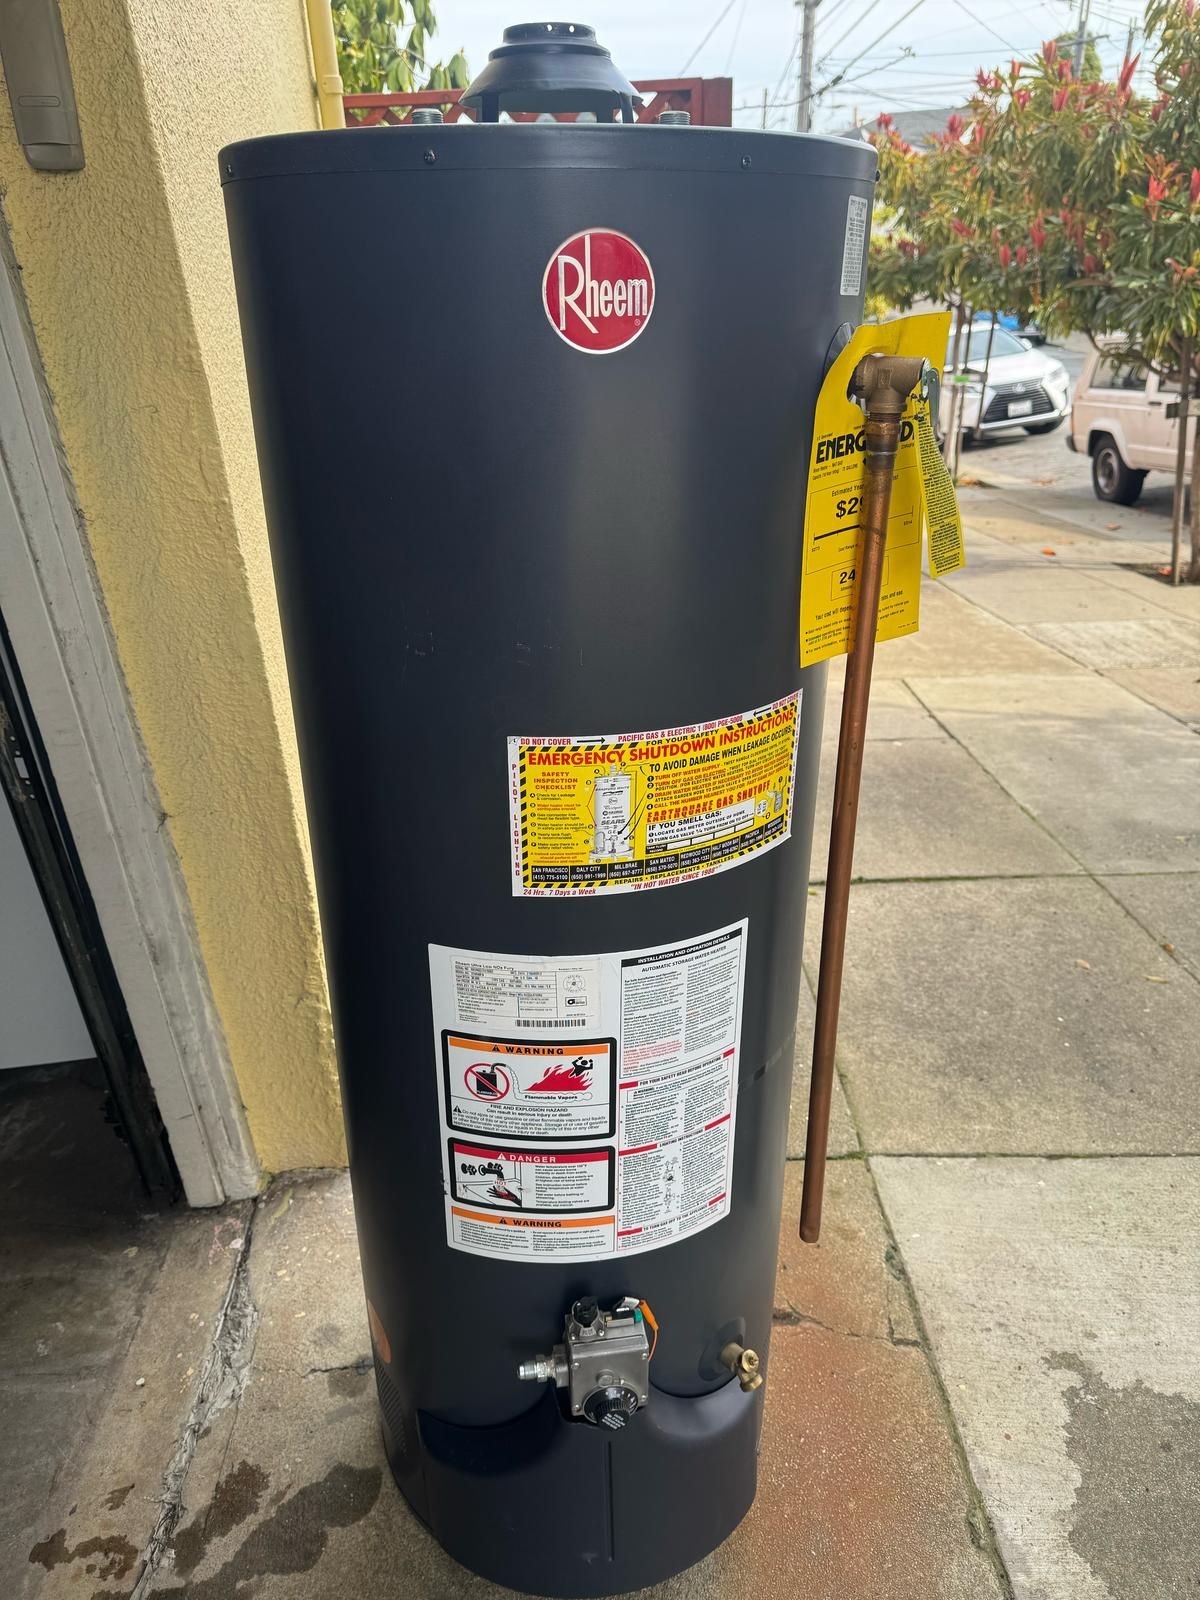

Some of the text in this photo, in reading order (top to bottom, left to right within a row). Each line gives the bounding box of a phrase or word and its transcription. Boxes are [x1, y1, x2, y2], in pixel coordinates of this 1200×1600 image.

[558, 234, 648, 333] Rheem
[528, 709, 794, 765] EMERGENCY SHUTDOWN INSTRUCTIONS
[618, 734, 644, 742] PACIFIC
[667, 726, 696, 736] ELECTRIC
[691, 730, 719, 739] SAFETY
[650, 764, 660, 772] TO
[663, 759, 687, 771] AVOID
[690, 752, 720, 766] DAMAGE
[722, 745, 741, 758] WHEN
[743, 735, 770, 752] LEAKAGE
[702, 764, 720, 772] SUPPLY
[647, 801, 713, 822] EARTHQUAKE
[716, 795, 733, 808] GAS
[737, 780, 770, 801] SHUTOFF
[678, 816, 703, 826] SMELL
[705, 811, 722, 819] GAS:
[706, 816, 725, 825] OUTSIDE
[650, 866, 700, 880] REPLACEMENTS
[706, 854, 734, 867] TANKLESS
[658, 877, 680, 887] WATER
[681, 872, 699, 881] SINCE
[638, 952, 674, 963] INSTALLATION
[642, 963, 671, 972] AUTOMATIC
[672, 957, 694, 966] STORAGE
[506, 1046, 564, 1054] WARNING
[510, 1154, 556, 1163] DANGER
